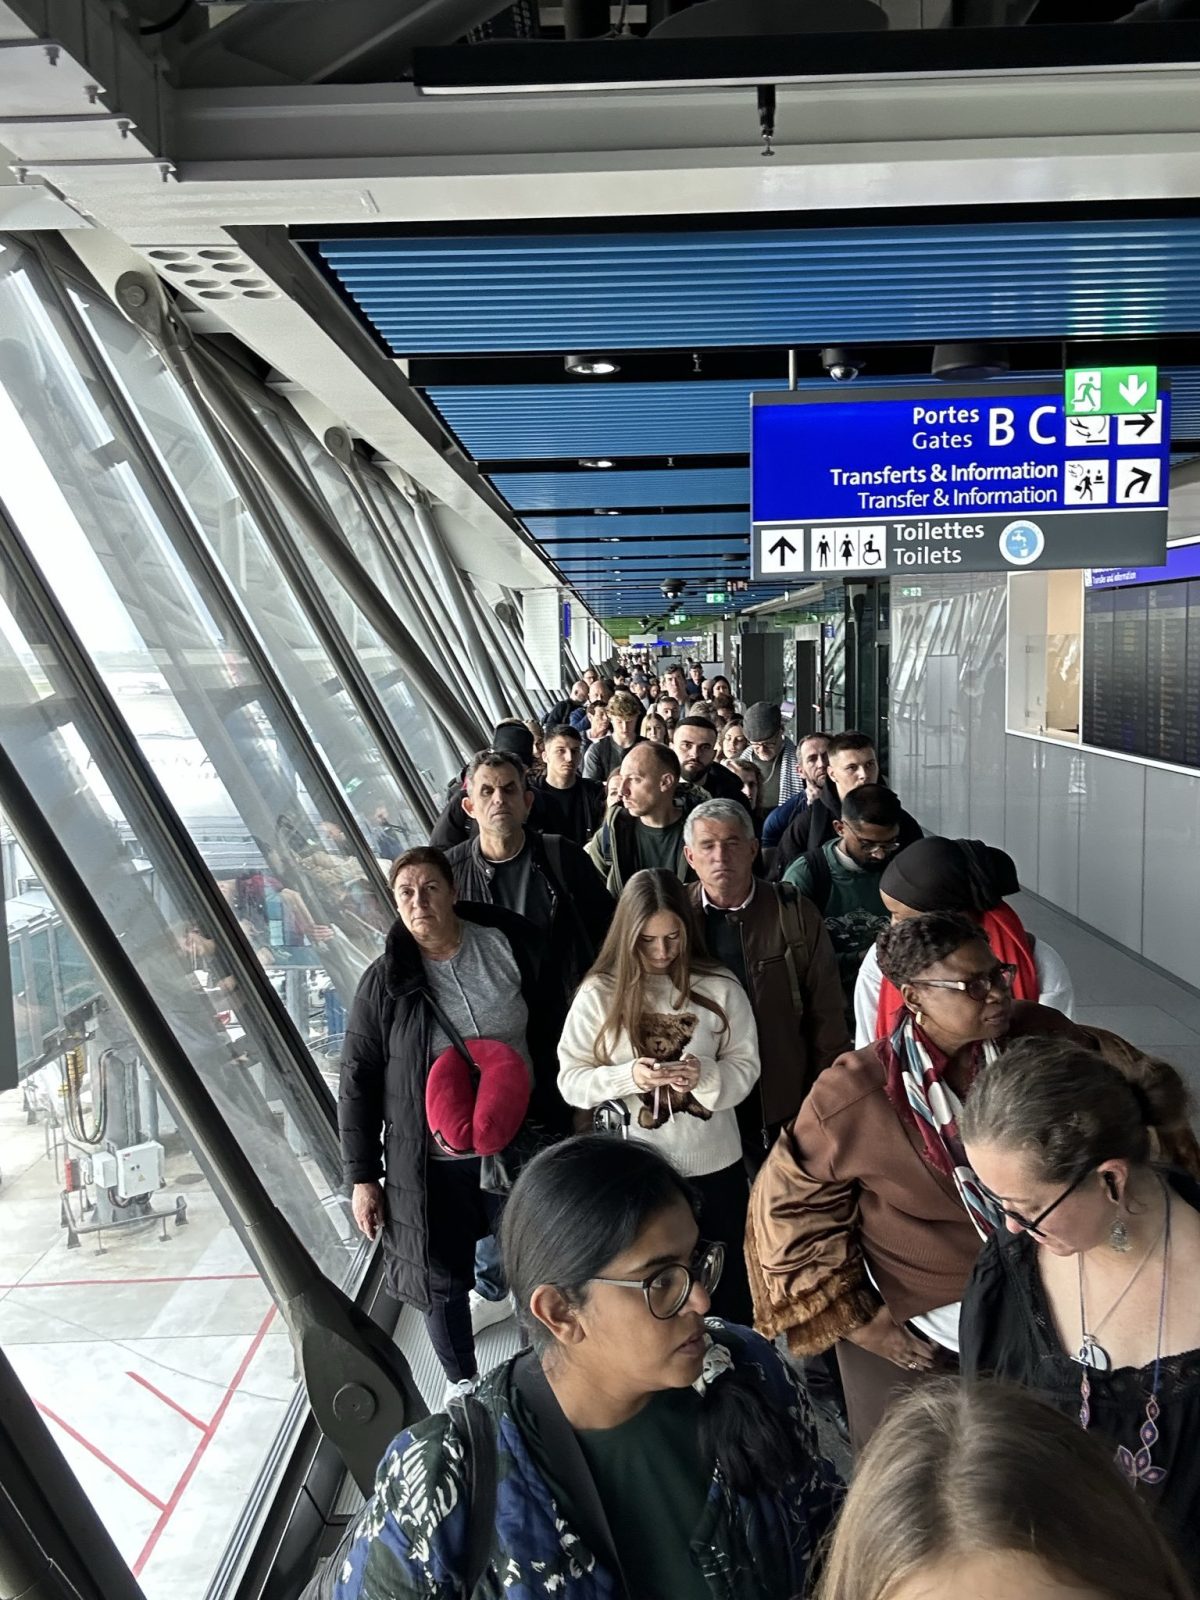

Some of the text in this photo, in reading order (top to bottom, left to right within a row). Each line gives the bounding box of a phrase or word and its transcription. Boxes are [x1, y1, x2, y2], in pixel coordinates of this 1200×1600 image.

[913, 406, 980, 425] Portes
[988, 405, 1058, 447] B C
[912, 431, 973, 450] Gates
[831, 461, 1059, 486] Transferts & Information
[858, 486, 1058, 509] Transfer & Information
[893, 521, 985, 542] Toilettes
[893, 545, 962, 566] Toilets
